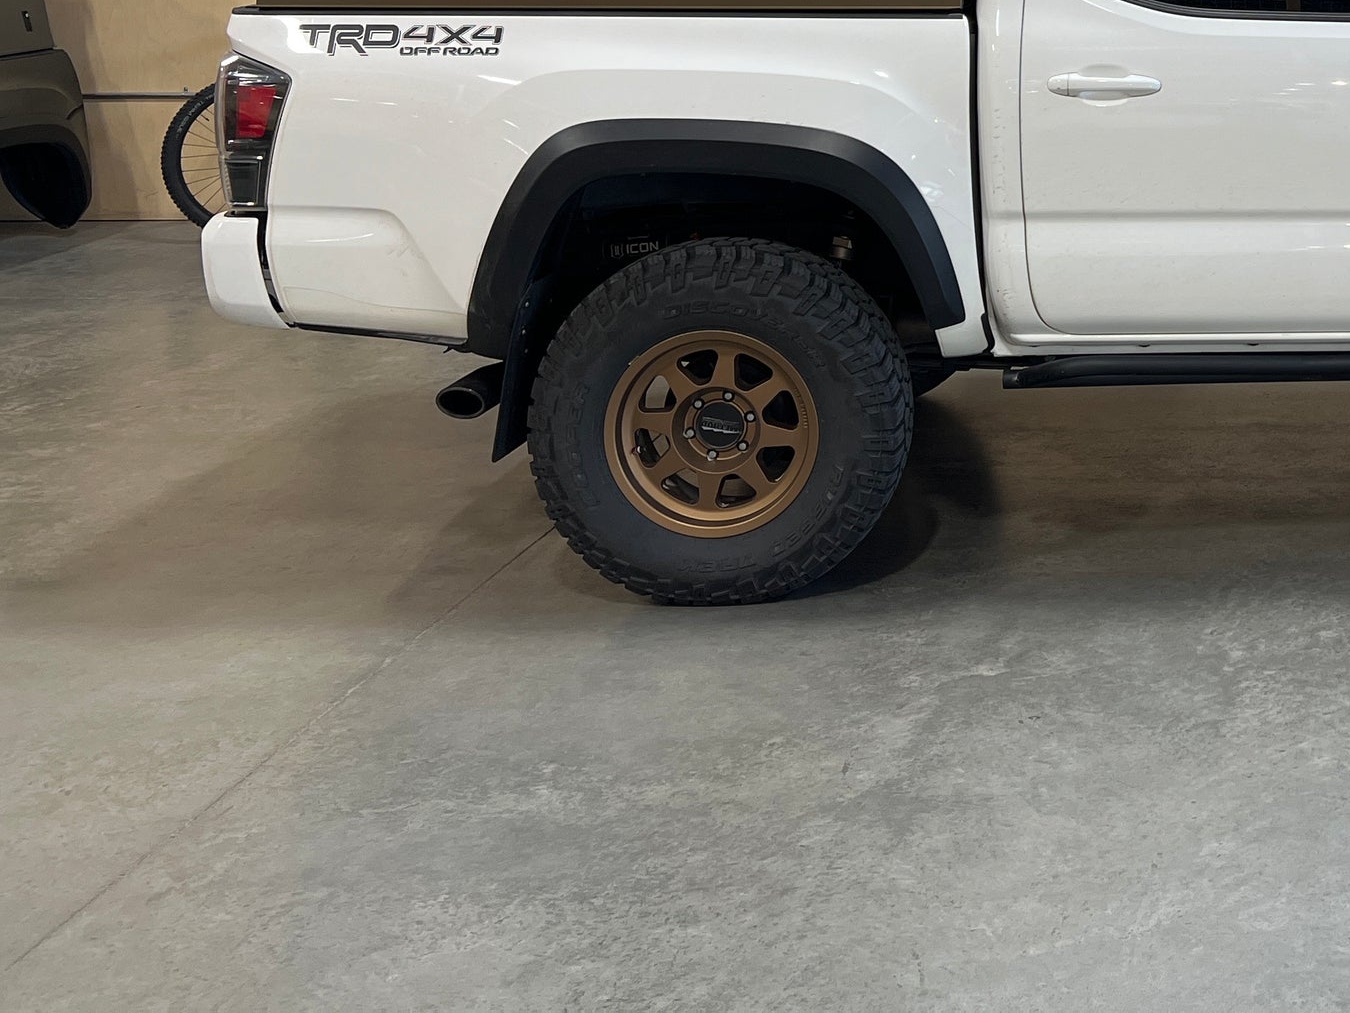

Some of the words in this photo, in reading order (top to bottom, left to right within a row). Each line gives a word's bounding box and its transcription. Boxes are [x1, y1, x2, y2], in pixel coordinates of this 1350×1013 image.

[299, 23, 401, 57] TRD
[401, 23, 505, 47] 4X4
[399, 46, 442, 57] OFF
[442, 46, 500, 57] ROAD
[625, 240, 660, 255] ICON
